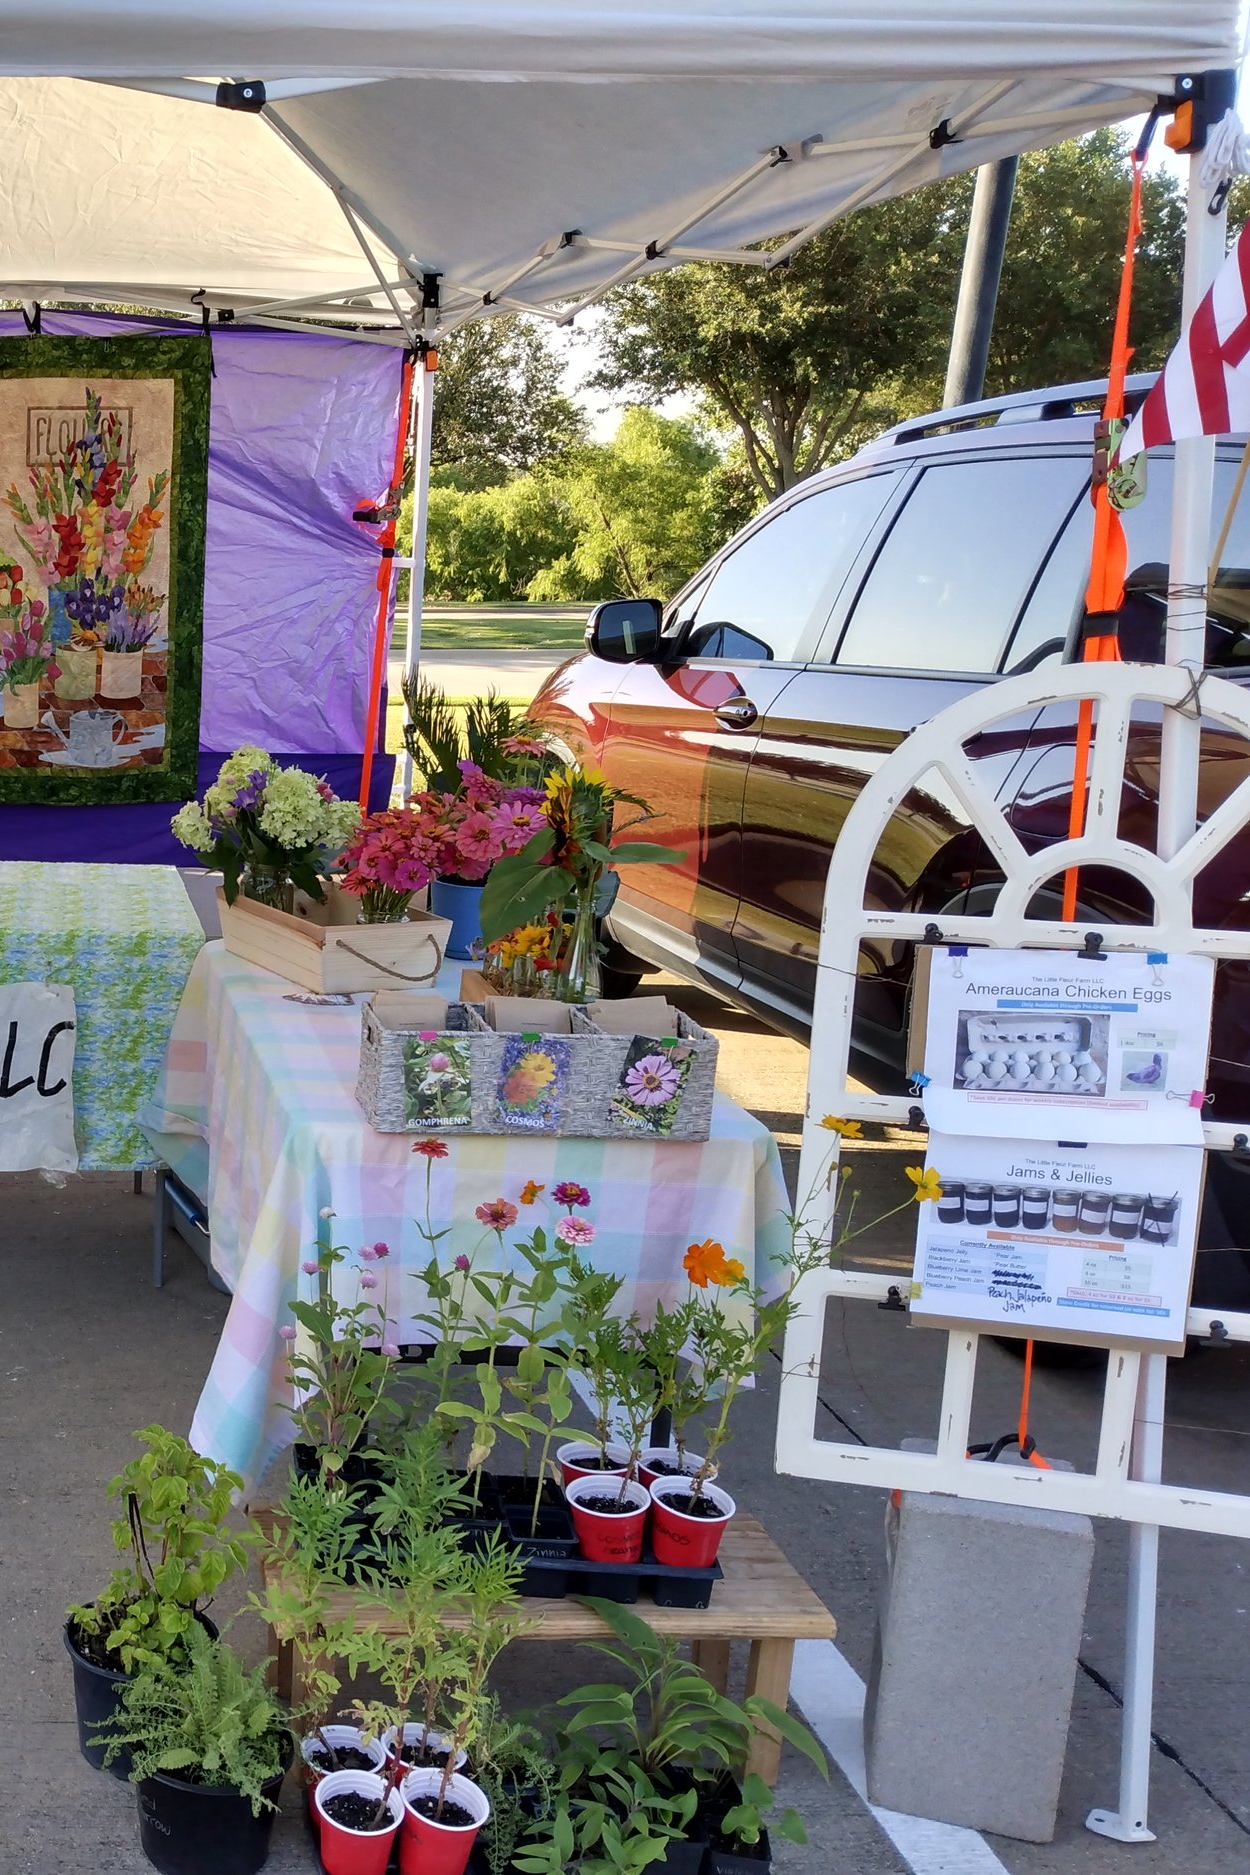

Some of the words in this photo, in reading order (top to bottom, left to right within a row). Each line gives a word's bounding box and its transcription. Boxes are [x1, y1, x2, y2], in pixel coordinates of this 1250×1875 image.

[965, 982, 1060, 997] Ameraucana
[1065, 984, 1127, 999] Chicken
[1132, 987, 1172, 1003] Eggs
[1136, 1031, 1157, 1039] Pricing
[408, 1116, 468, 1127] GOMPHRENA
[505, 1115, 545, 1129] COSMOS
[622, 1117, 654, 1131] ZINNIA
[1006, 1165, 1045, 1180] Jams
[1050, 1168, 1061, 1180] &
[1066, 1170, 1112, 1185] Jellies
[959, 1240, 988, 1249] Currently
[988, 1243, 1015, 1251] Available
[928, 1254, 958, 1263] Blackberry
[1109, 1254, 1127, 1262] Pricing
[927, 1263, 954, 1272] Blueberry
[926, 1272, 952, 1281] Blueberry
[987, 1286, 1014, 1301] Peach
[527, 1547, 567, 1558] Zinnia
